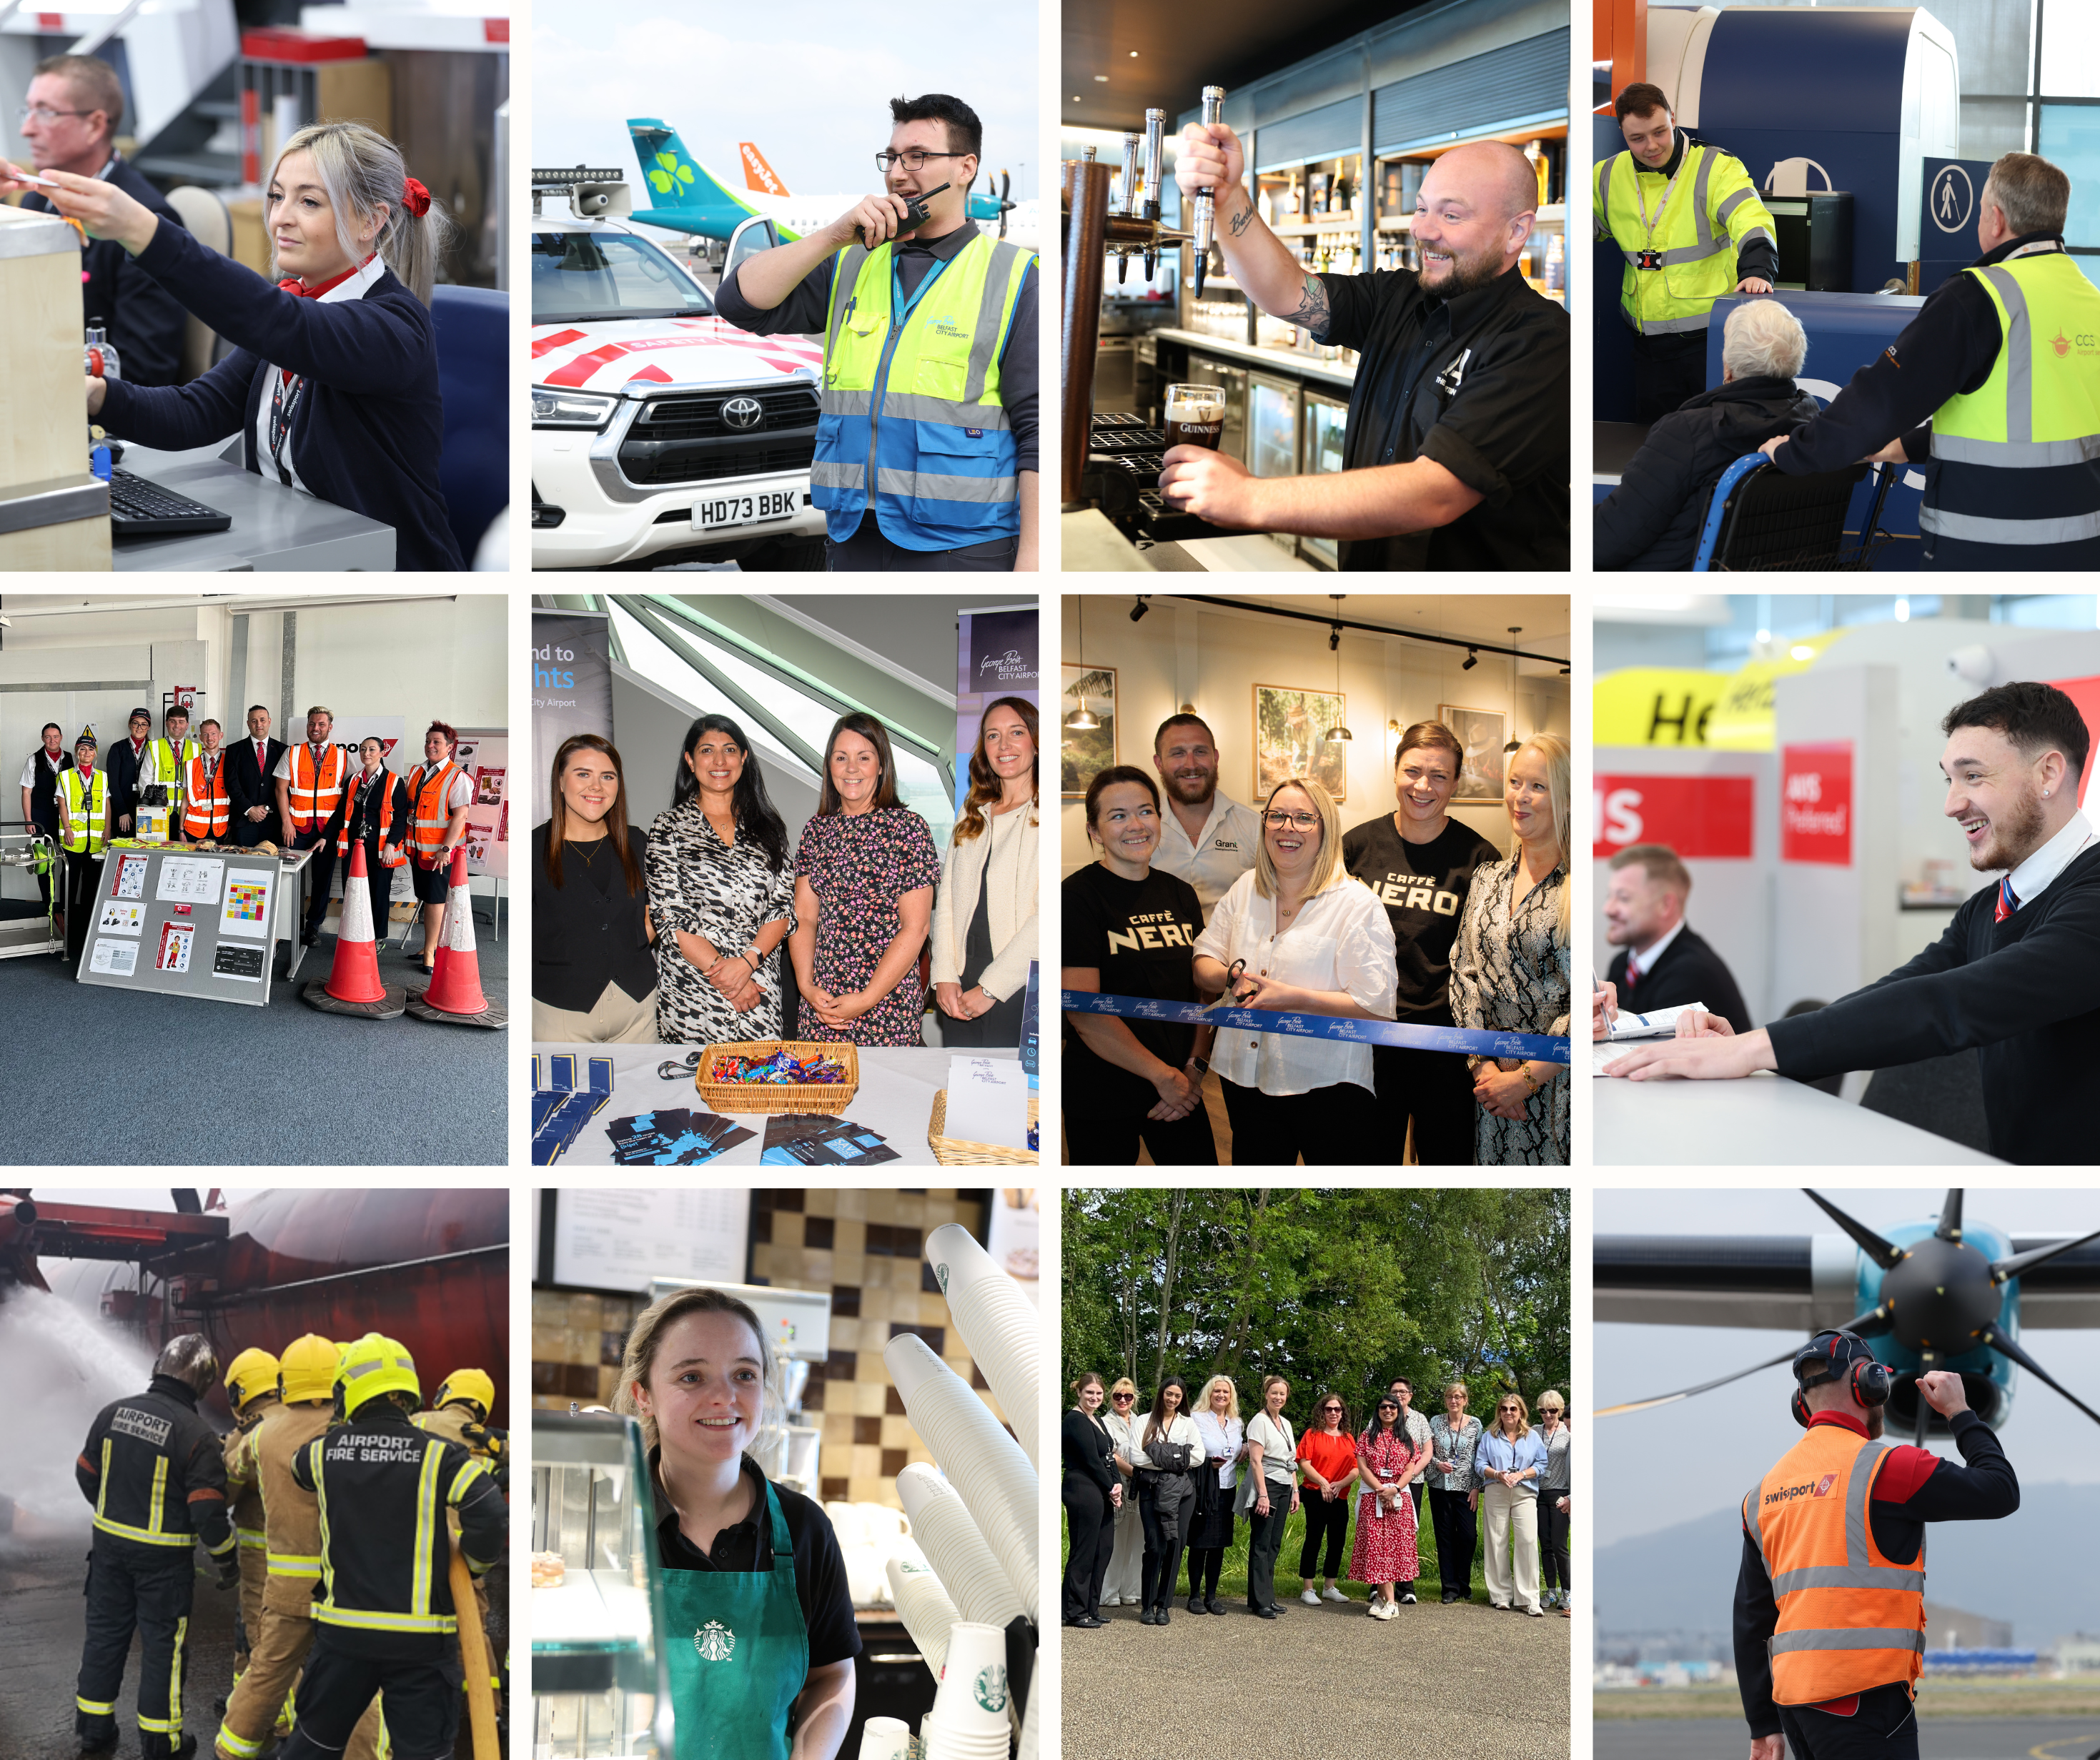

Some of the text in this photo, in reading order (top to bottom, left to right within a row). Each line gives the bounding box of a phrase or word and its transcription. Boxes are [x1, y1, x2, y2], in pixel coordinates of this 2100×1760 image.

[742, 145, 778, 194] easyJet
[630, 338, 708, 348] SAFETY
[2076, 334, 2095, 347] CCS
[1888, 346, 1898, 356] CCS
[1435, 376, 1447, 387] THE
[287, 389, 301, 417] swissport
[702, 492, 795, 524] HD73 BBK
[555, 646, 575, 662] to
[980, 650, 1024, 677] George Best
[547, 698, 577, 709] Airport
[1215, 840, 1238, 848] Grant
[1387, 872, 1436, 887] CAFFÈ
[1129, 910, 1174, 925] CAFFÈ
[834, 1138, 861, 1155] SAVE
[117, 1408, 170, 1433] AIRPORT
[131, 1425, 166, 1444] SERVICE
[337, 1434, 414, 1449] AIRPORT
[326, 1448, 421, 1463] FIRE SERVICE
[1765, 1481, 1816, 1505] swissport
